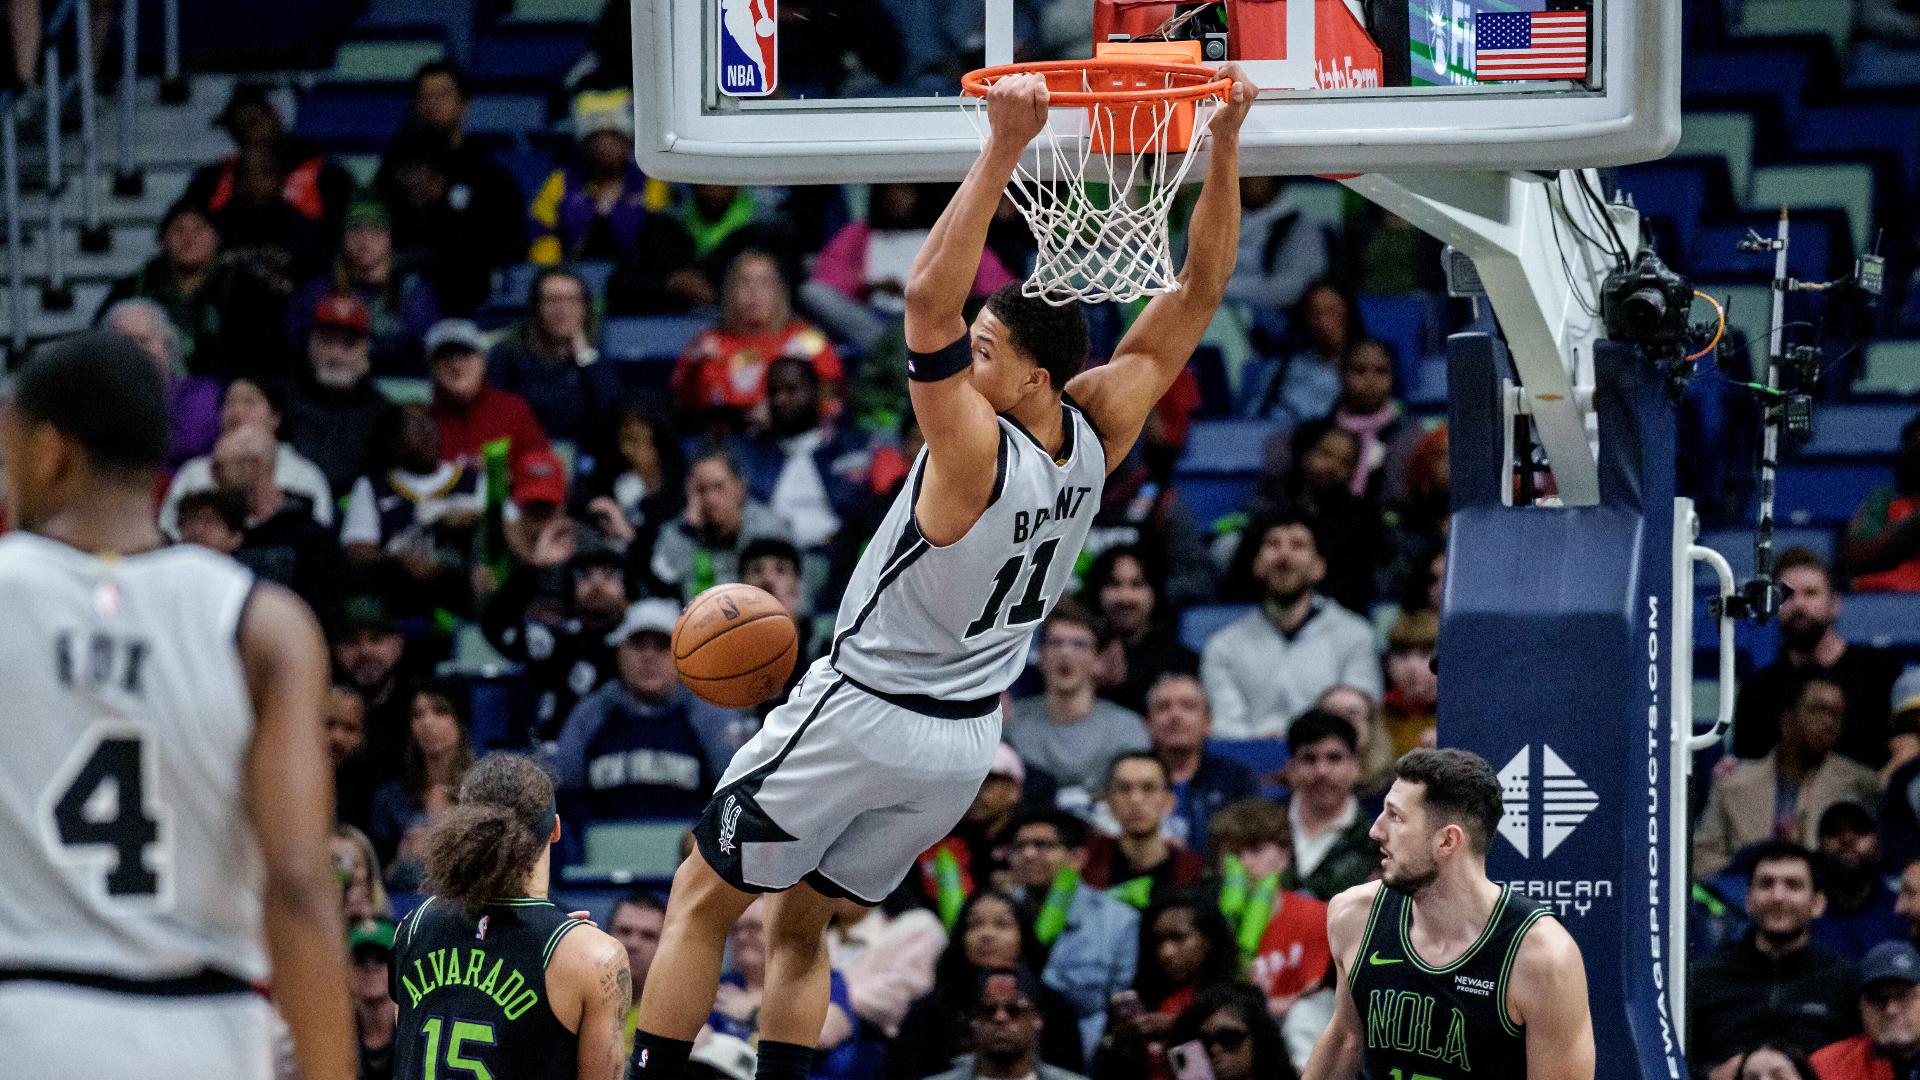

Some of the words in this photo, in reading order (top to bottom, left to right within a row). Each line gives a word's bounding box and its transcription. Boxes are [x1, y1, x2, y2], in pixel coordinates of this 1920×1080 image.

[727, 64, 755, 87] NBA
[961, 535, 1064, 641] 11
[48, 730, 165, 900] 4
[1509, 880, 1612, 897] ERICAN
[402, 947, 539, 1021] ALVARADO
[1454, 974, 1496, 990] NEWAGE
[1456, 985, 1490, 997] PRODUCTS
[420, 1015, 499, 1080] 15
[1367, 989, 1472, 1072] NOLA
